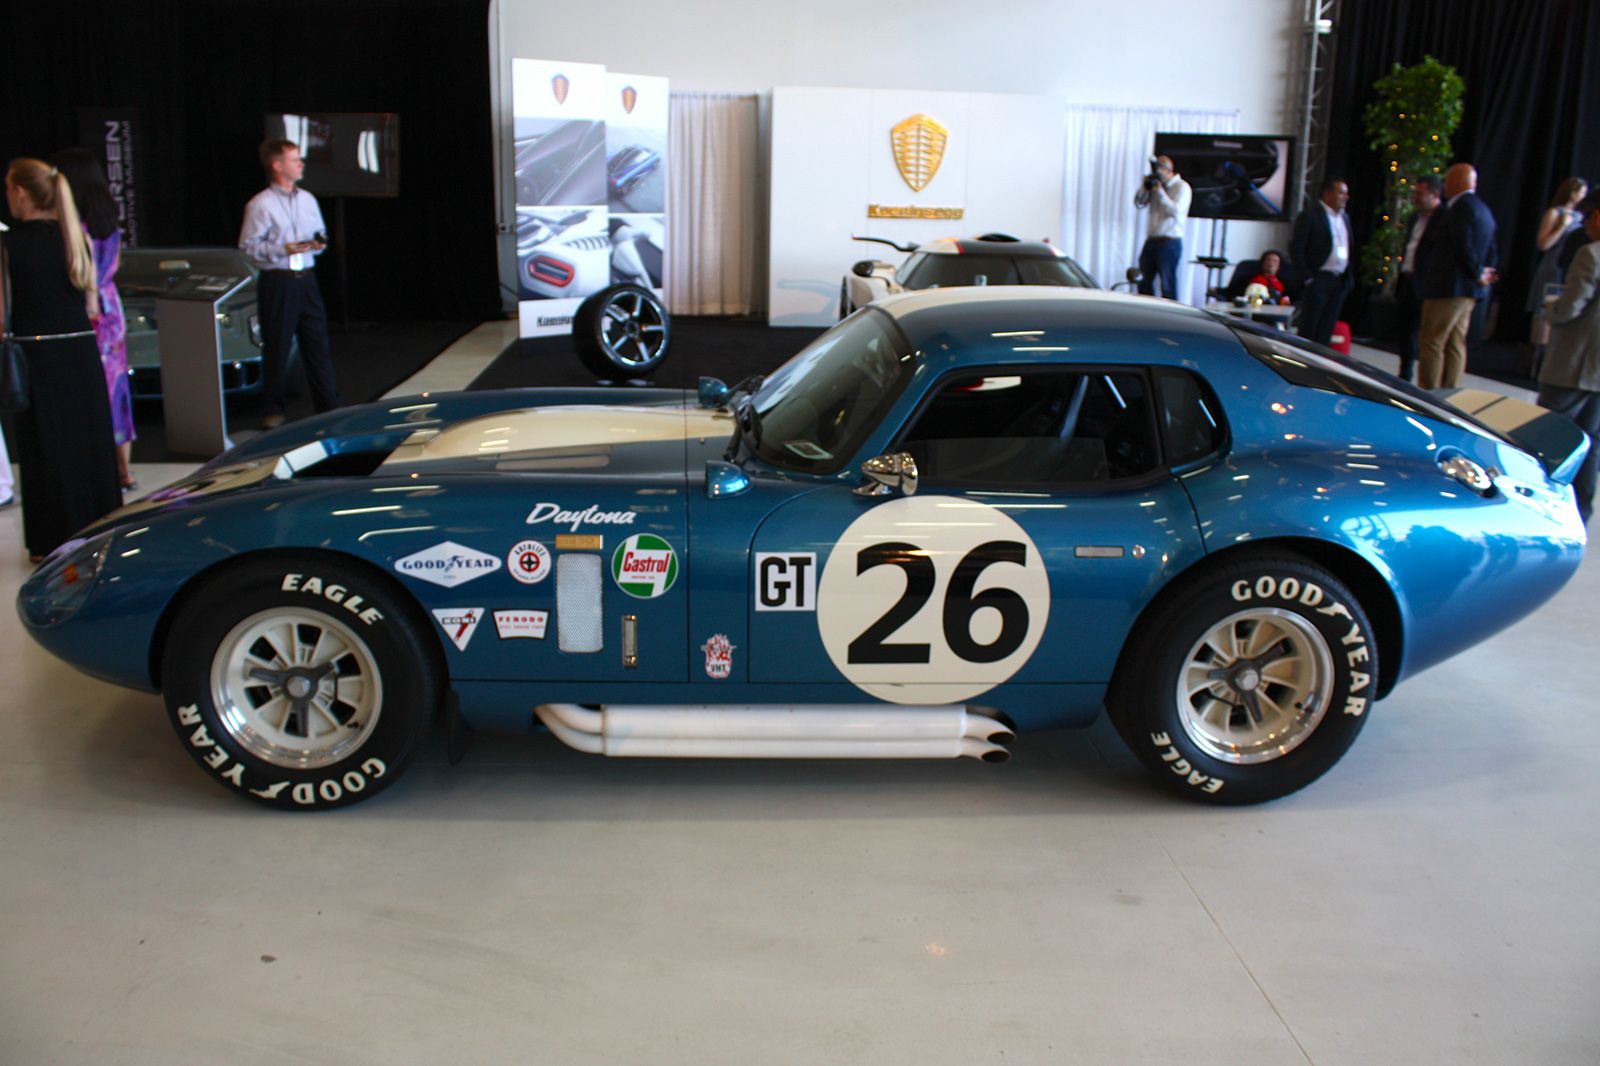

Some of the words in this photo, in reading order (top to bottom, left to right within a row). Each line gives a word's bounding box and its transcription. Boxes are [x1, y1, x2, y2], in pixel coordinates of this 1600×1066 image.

[525, 502, 637, 533] Daytona
[623, 551, 670, 573] Castrol
[760, 556, 812, 607] GT
[281, 573, 384, 625] EAGLE
[847, 540, 1029, 664] 26
[1150, 730, 1224, 794] EAGLE
